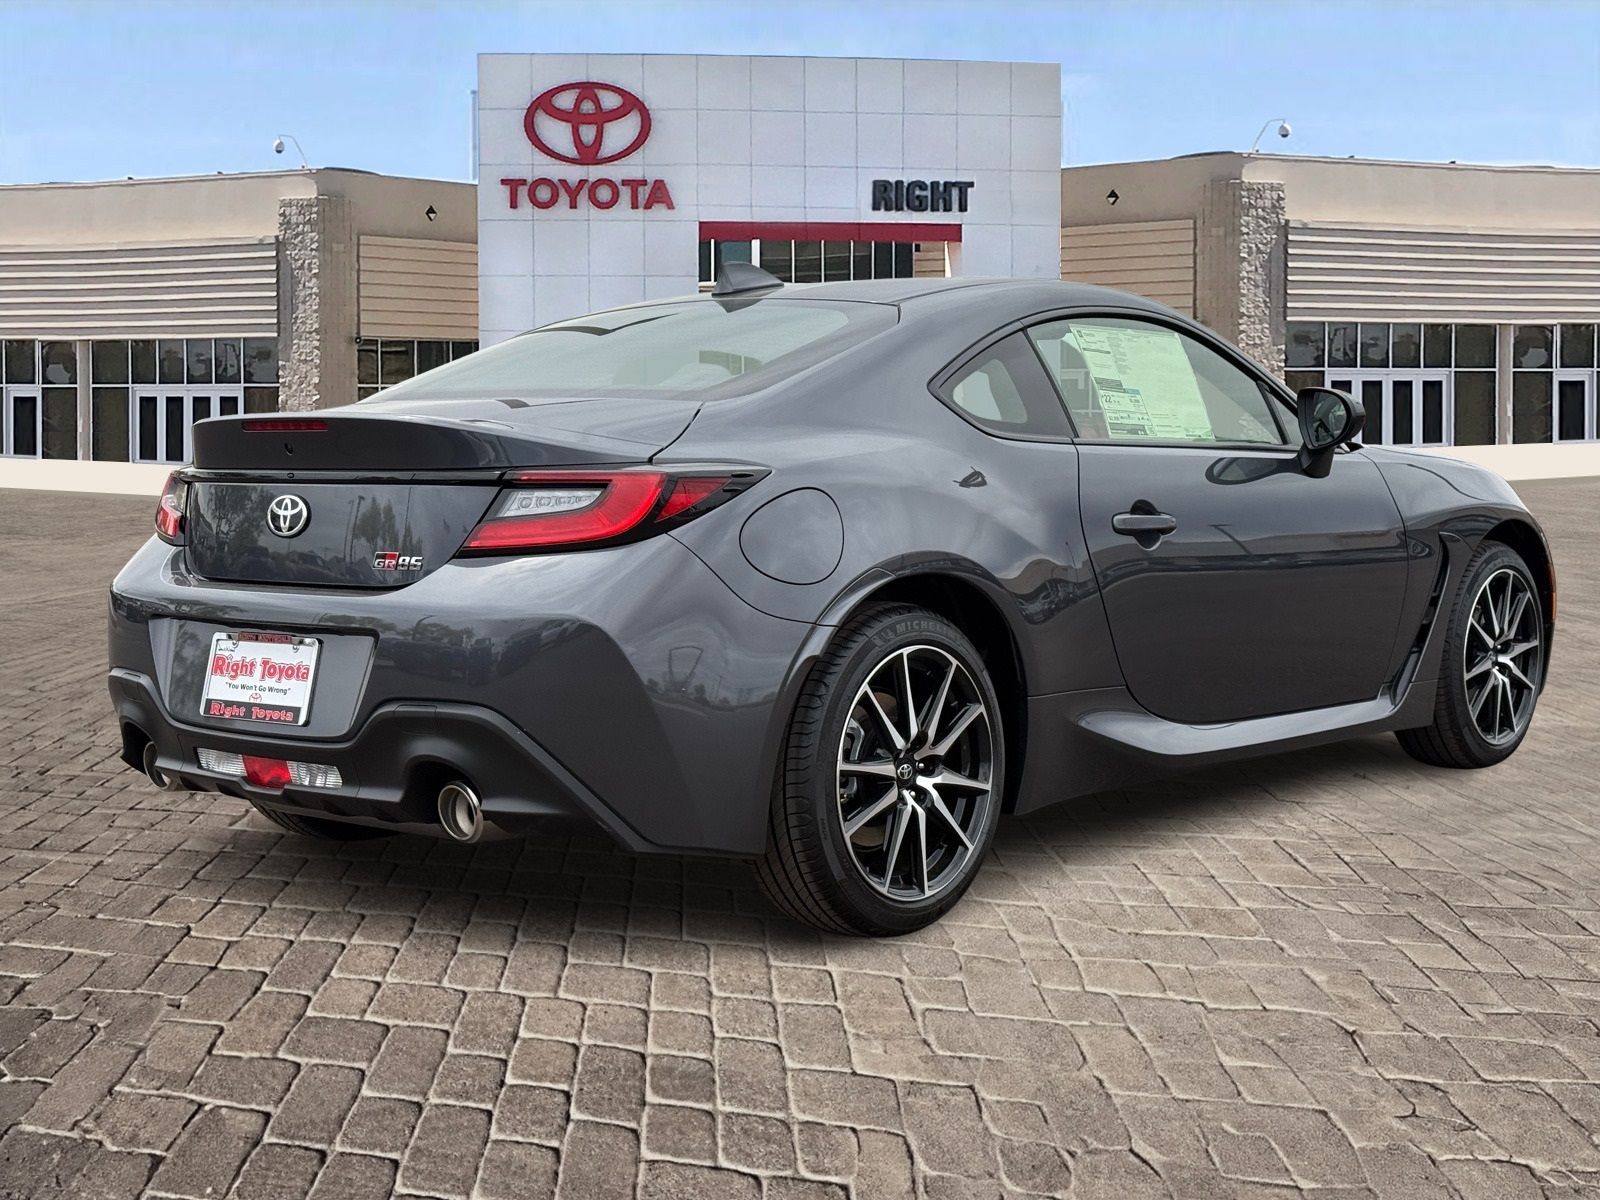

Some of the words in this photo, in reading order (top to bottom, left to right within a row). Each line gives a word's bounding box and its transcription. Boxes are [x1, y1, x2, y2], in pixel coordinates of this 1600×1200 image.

[500, 178, 675, 210] TOYOTA
[871, 179, 976, 212] RIGHT
[211, 653, 257, 680] Right
[259, 657, 311, 683] Toyota
[240, 683, 257, 691] Won't
[210, 701, 246, 717] Right
[251, 706, 294, 721] Toyota
